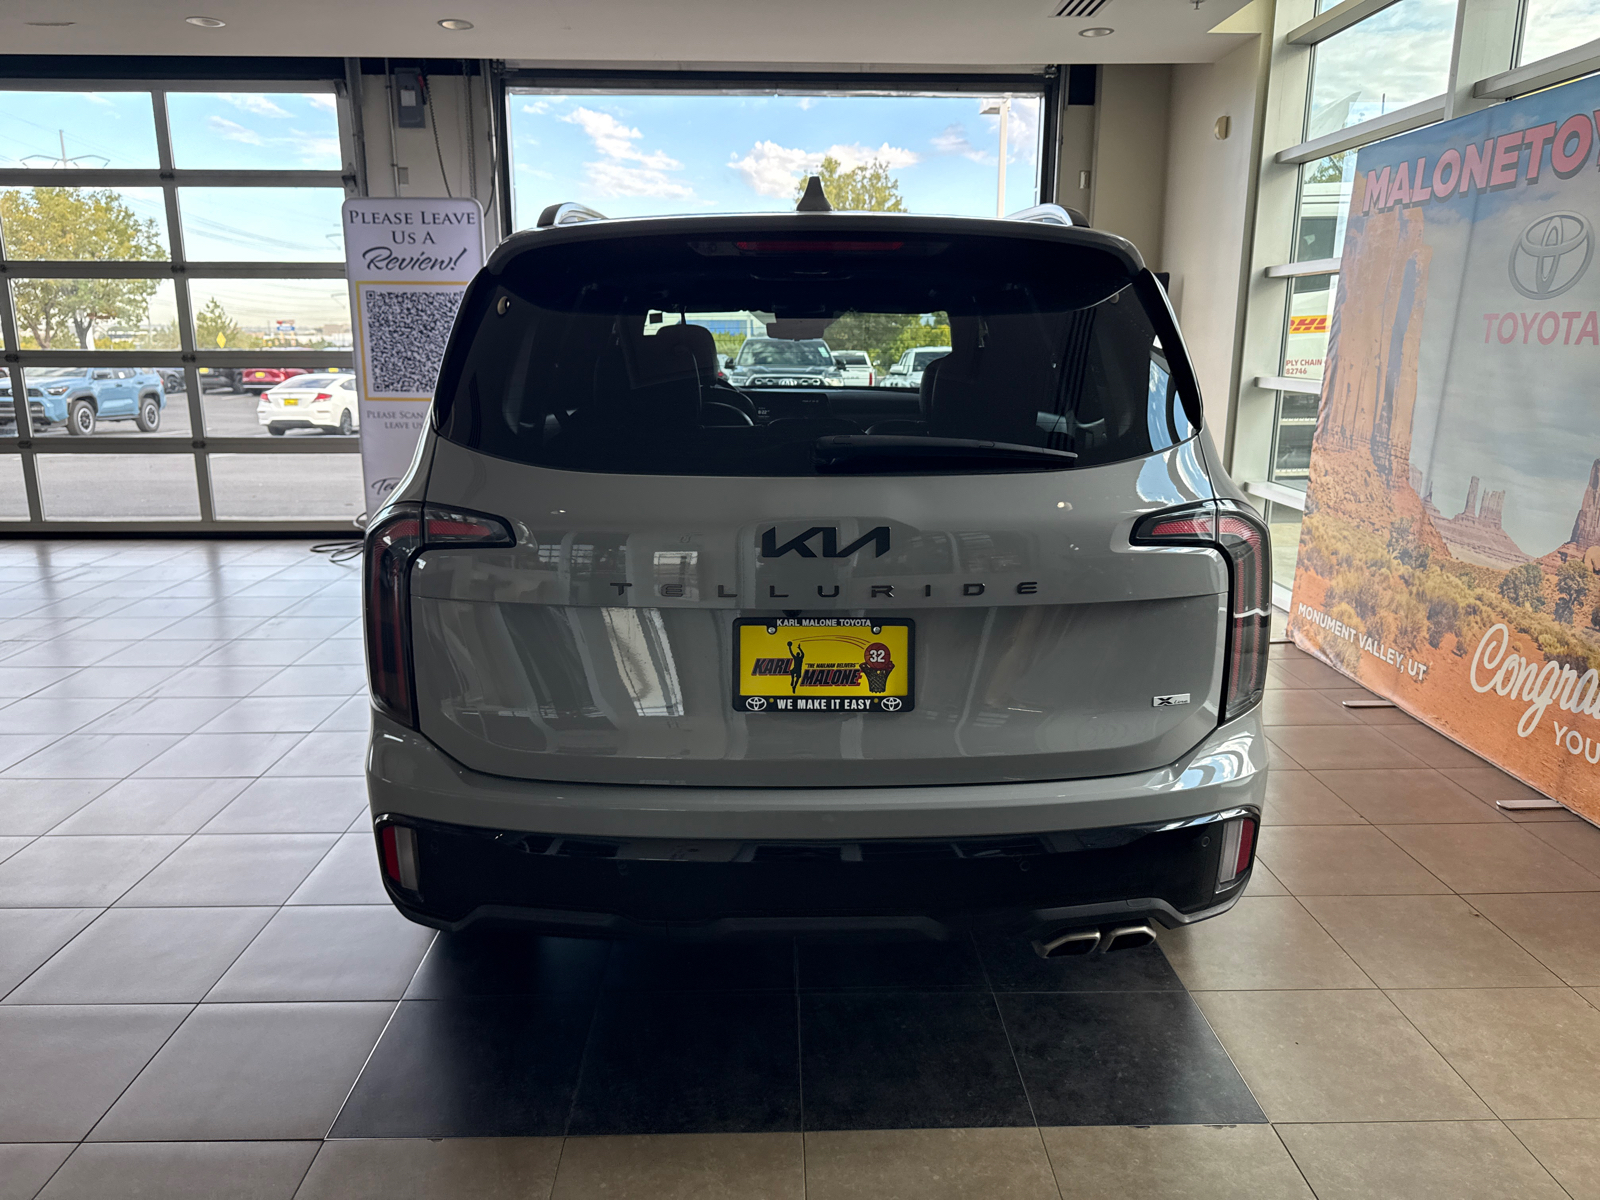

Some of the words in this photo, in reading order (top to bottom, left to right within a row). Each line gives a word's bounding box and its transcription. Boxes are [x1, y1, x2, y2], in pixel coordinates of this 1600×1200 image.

[1361, 108, 1600, 215] MALONETO
[348, 210, 414, 225] PLEASE
[420, 211, 476, 225] LEAVE
[391, 230, 417, 245] US
[421, 231, 437, 245] A
[362, 246, 468, 271] Review!
[1483, 310, 1600, 346] TOYOTA
[366, 410, 397, 419] PLEASE
[399, 410, 424, 419] SCAN
[384, 421, 409, 429] LEAVE
[761, 526, 891, 558] KIA
[609, 581, 1038, 598] TELLURIDE
[776, 619, 800, 627] KARL
[802, 619, 838, 627] MALONE
[839, 619, 872, 627] TOYOTA
[1298, 602, 1357, 643] MONUMENT
[1358, 632, 1405, 674] VALLEY,
[1407, 658, 1427, 681] UT
[869, 649, 885, 663] 32
[751, 658, 794, 676] KARL
[800, 668, 862, 687] MALONE
[777, 698, 793, 710] WE
[797, 698, 827, 710] MAKE
[831, 698, 841, 710] IT
[844, 698, 871, 710] EASY
